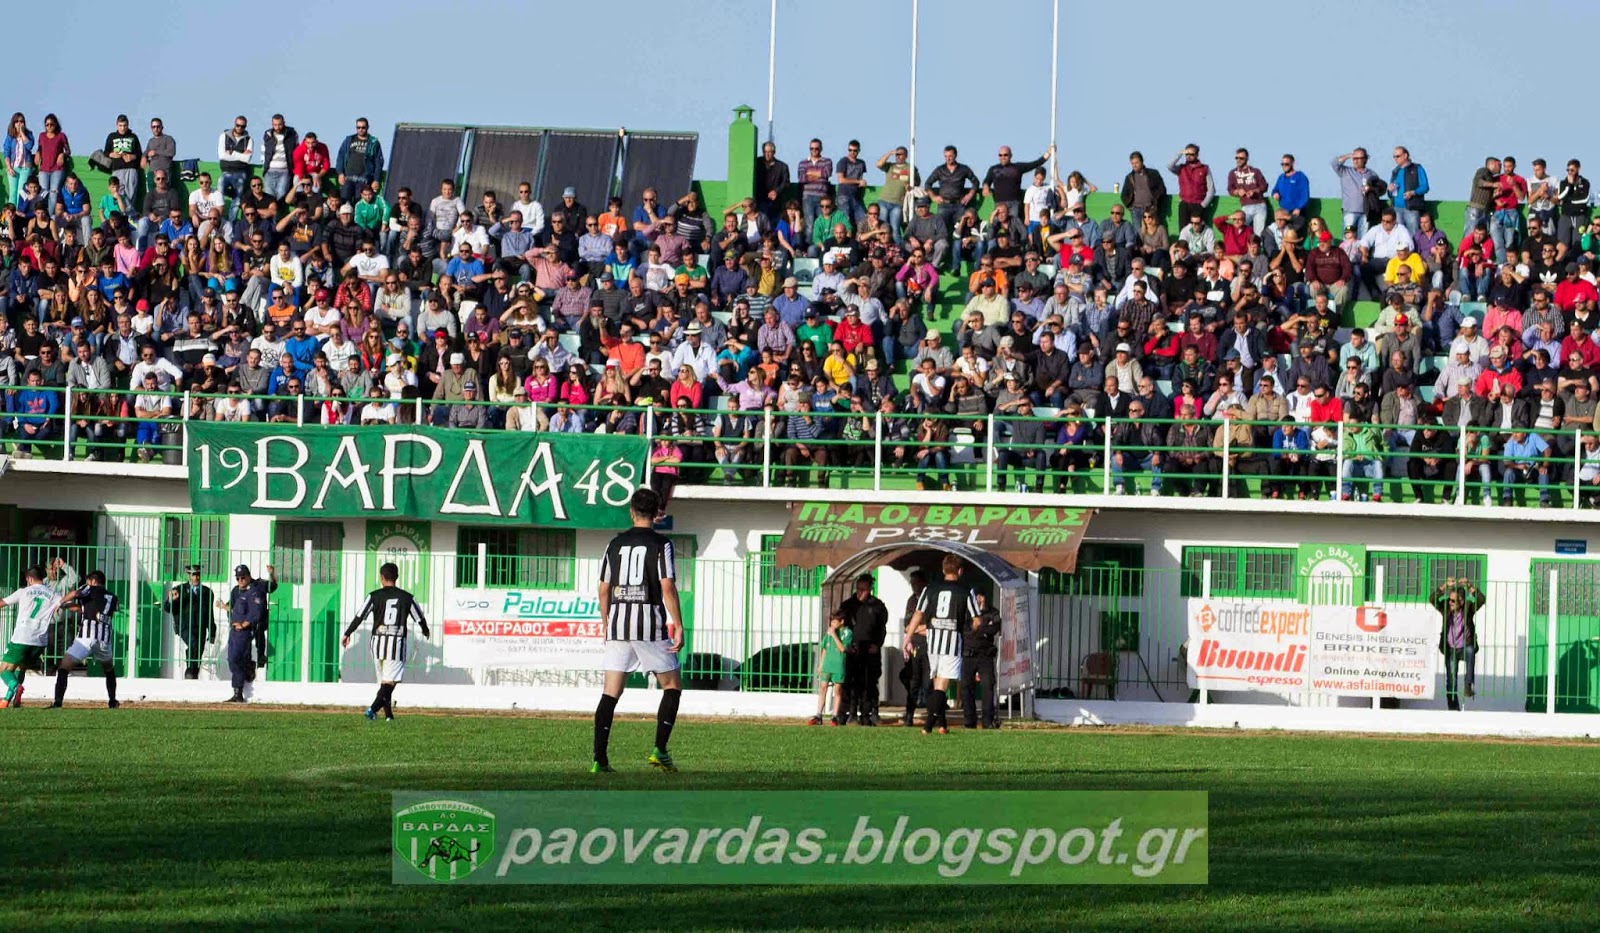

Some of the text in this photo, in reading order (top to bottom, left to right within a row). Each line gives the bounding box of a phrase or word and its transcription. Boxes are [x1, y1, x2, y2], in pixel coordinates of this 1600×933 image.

[195, 433, 635, 519] 19 ΒΑΡΔΑ 48
[386, 546, 408, 556] 1948
[618, 545, 647, 586] 10
[1328, 546, 1363, 577] ΒΑΡΔΑΣ
[1321, 571, 1342, 580] 1948
[30, 597, 45, 619] 7
[384, 598, 399, 625] 6
[936, 590, 952, 618] 8
[459, 621, 550, 636] ΤΑΧΟΓΡΑΦΟΙ
[1197, 639, 1308, 673] Buondi
[1324, 643, 1417, 656] BROKERS
[1247, 675, 1303, 686] espresso
[1324, 666, 1360, 676] Online
[1313, 679, 1426, 696] www.asfaliamou.gr
